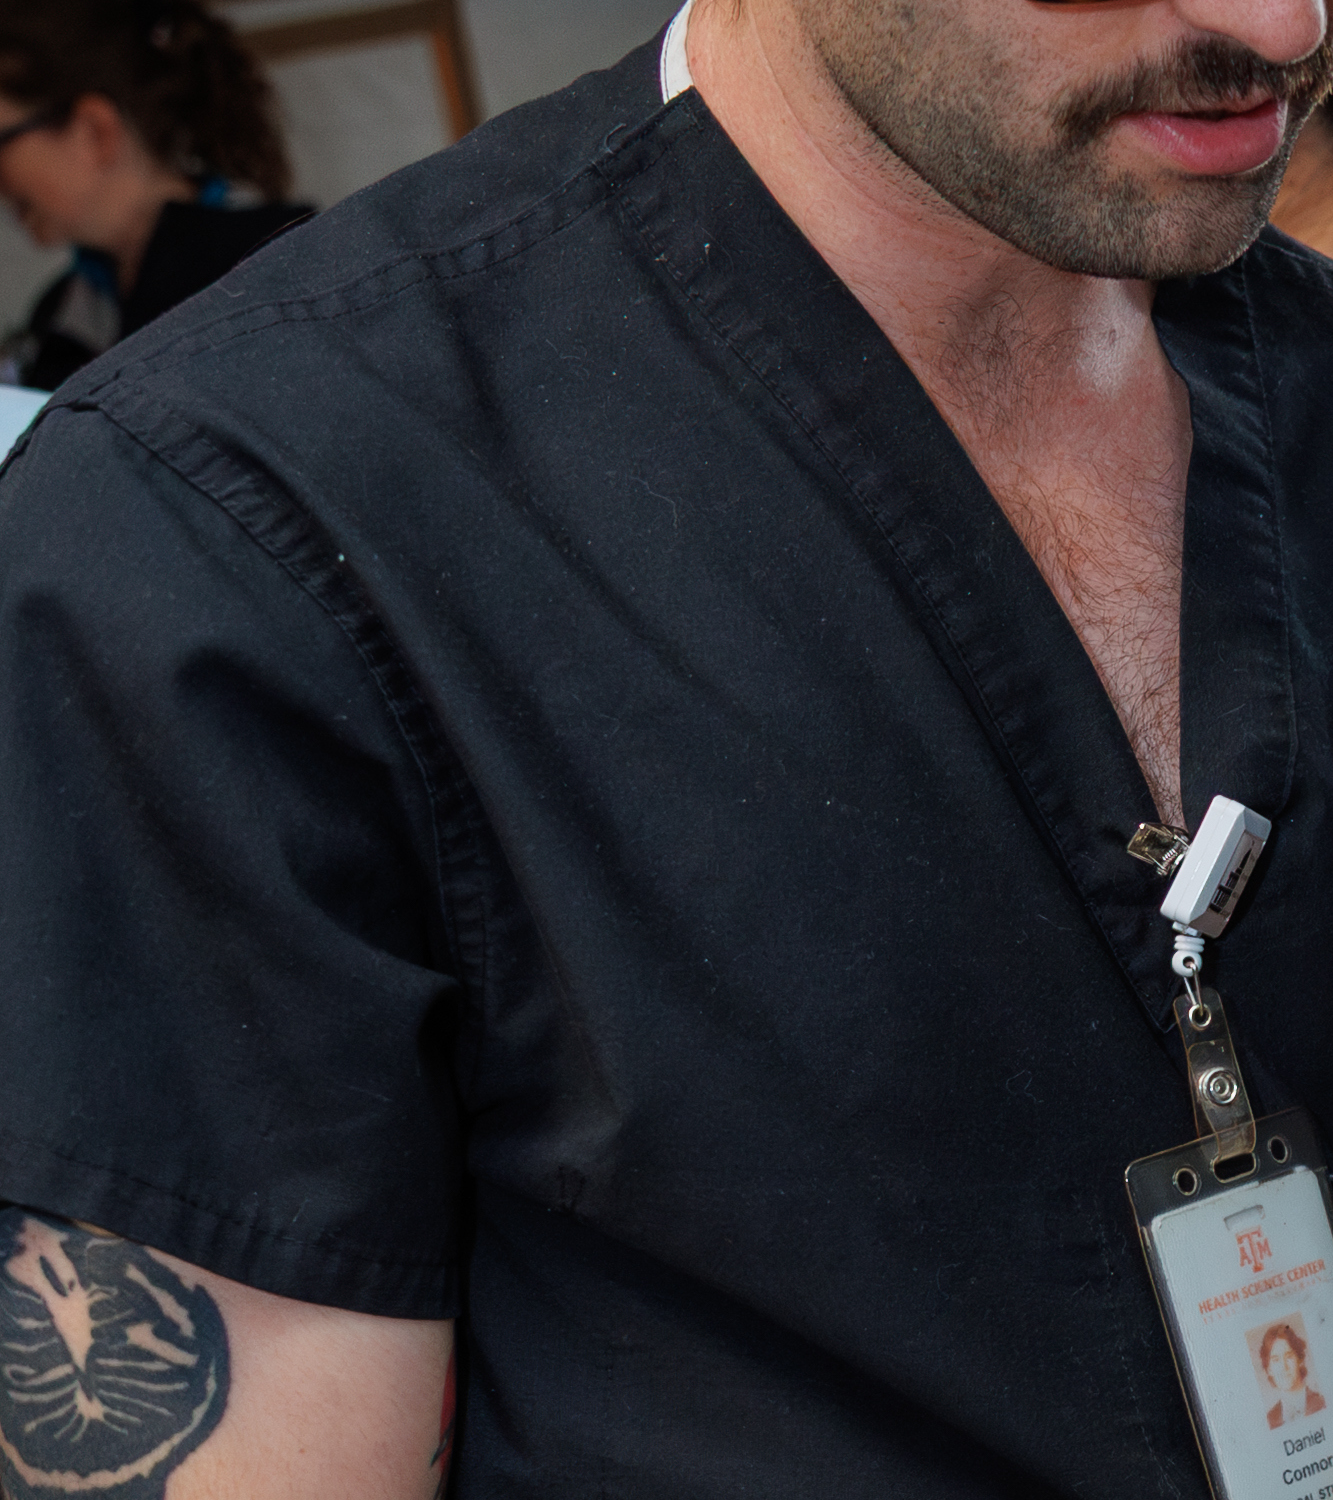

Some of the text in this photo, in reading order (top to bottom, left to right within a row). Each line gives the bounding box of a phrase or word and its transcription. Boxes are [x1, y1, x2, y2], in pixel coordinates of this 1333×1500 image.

[1198, 1290, 1241, 1315] HEALTH
[1241, 1273, 1286, 1300] SCIENCE
[1286, 1258, 1326, 1283] CENTER
[1283, 1426, 1326, 1457] Daniel
